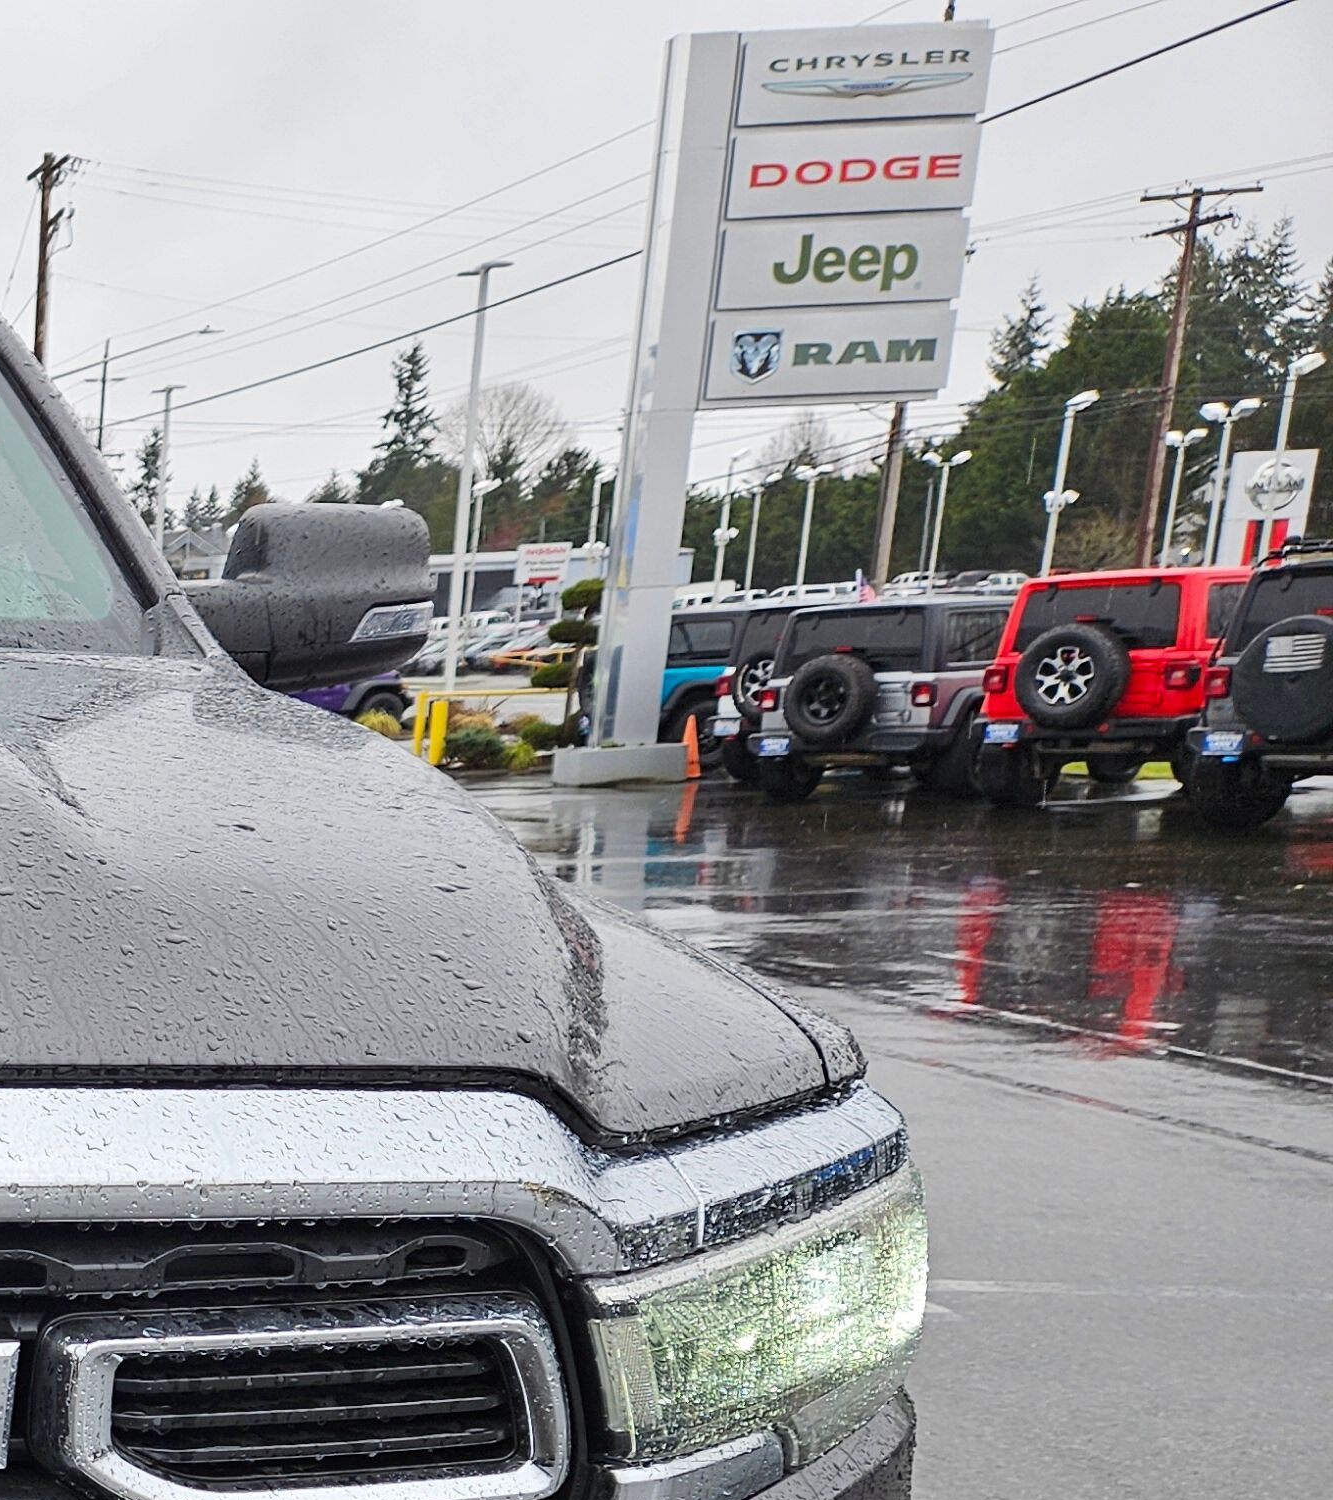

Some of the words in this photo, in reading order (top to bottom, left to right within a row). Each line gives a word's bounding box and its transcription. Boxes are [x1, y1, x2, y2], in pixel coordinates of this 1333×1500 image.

[769, 49, 972, 73] CHRYSLER
[749, 154, 963, 188] DODGE
[773, 233, 919, 291] Jeep
[791, 337, 938, 367] RAM
